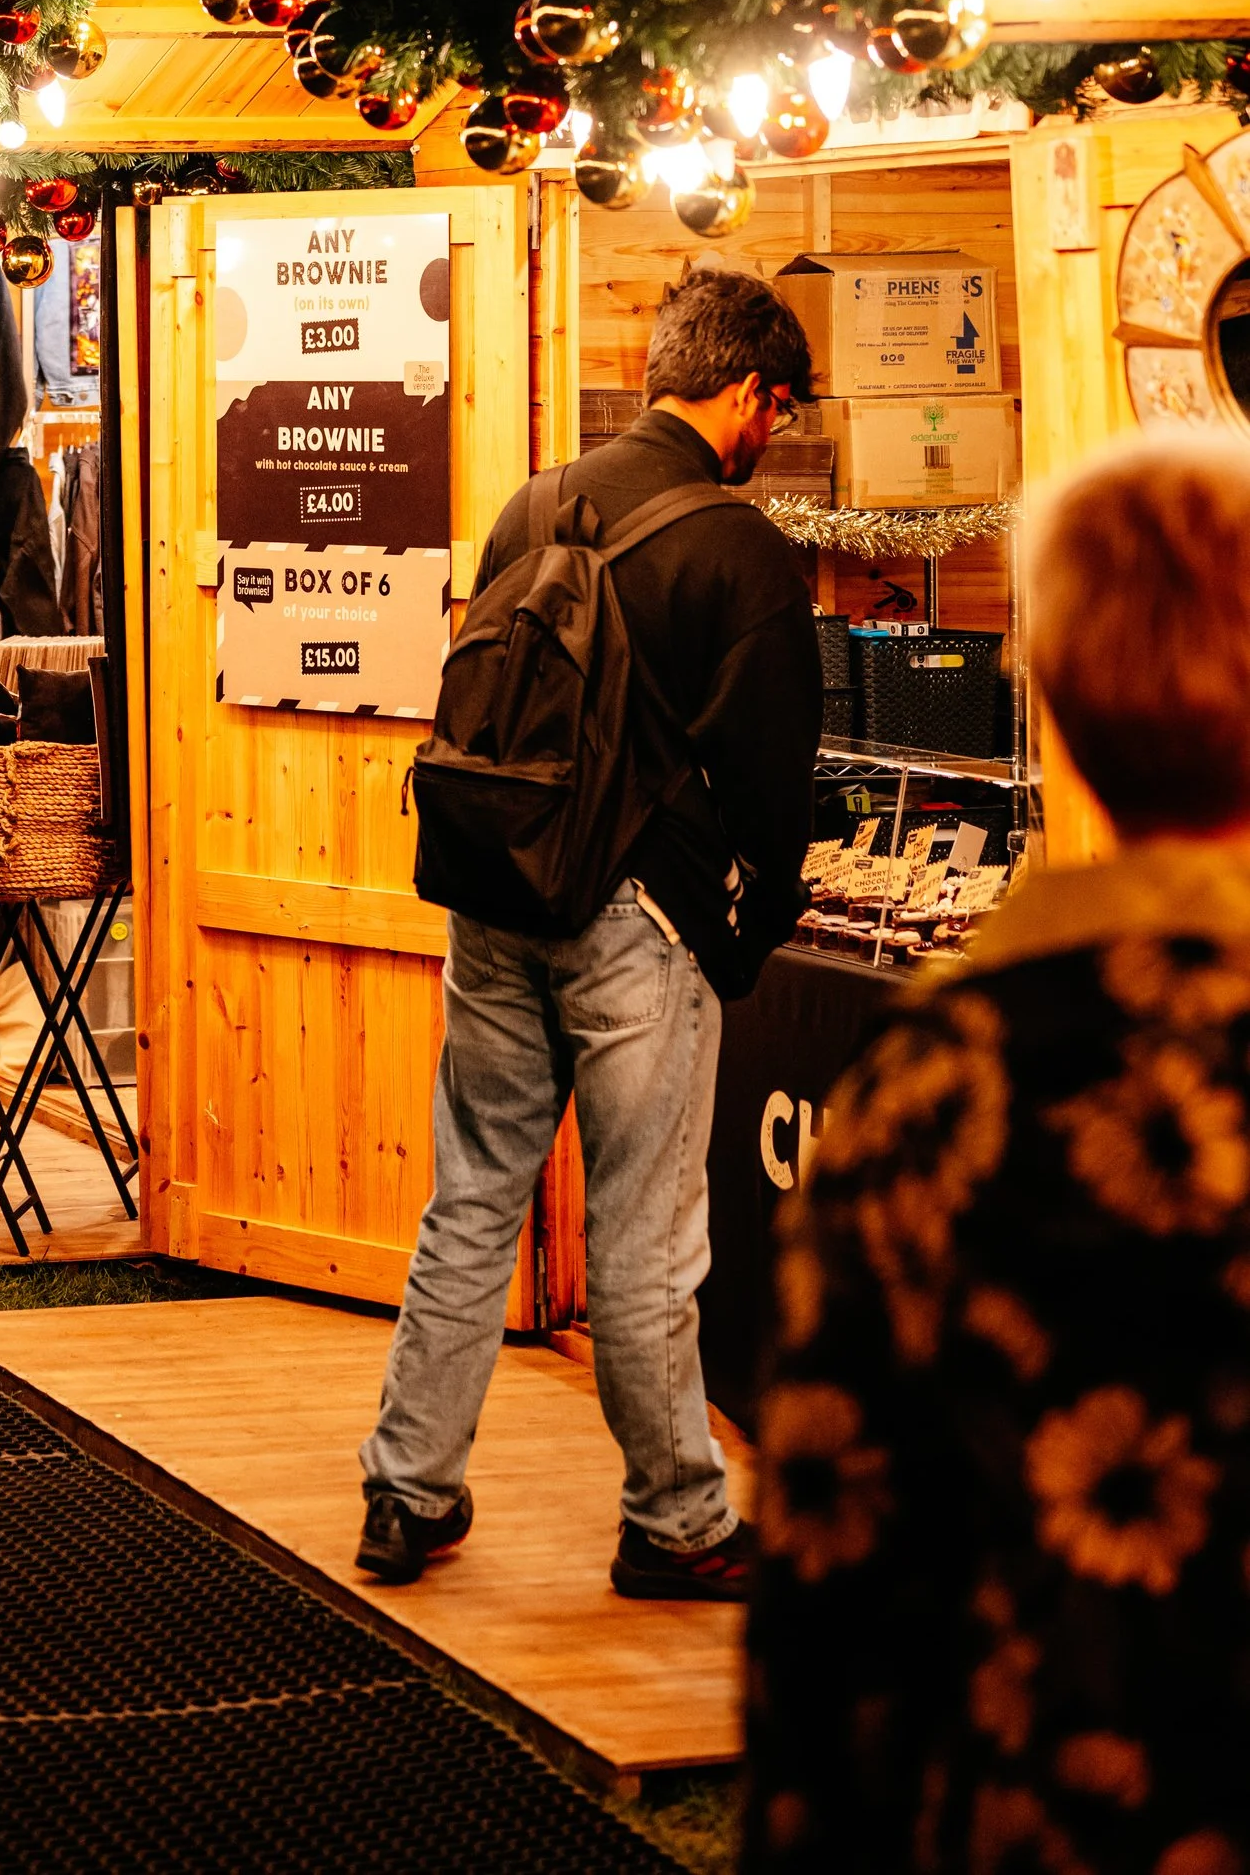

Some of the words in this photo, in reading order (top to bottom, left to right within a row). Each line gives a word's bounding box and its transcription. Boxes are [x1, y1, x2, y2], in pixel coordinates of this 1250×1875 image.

[307, 229, 356, 254] ANY
[276, 260, 388, 286] BROWNIE
[294, 296, 314, 312] (on
[318, 295, 334, 310] its
[338, 295, 370, 311] own)
[305, 325, 355, 349] £3.00
[946, 350, 985, 359] FRAGILE
[419, 364, 430, 373] The
[413, 373, 435, 382] deluxe
[413, 383, 435, 391] version
[307, 386, 354, 410] ANY
[277, 427, 385, 452] BROWNIE
[910, 433, 958, 442] edenware
[255, 459, 275, 470] with
[276, 459, 291, 470] hot
[293, 460, 338, 471] chocolate
[340, 462, 367, 472] sauce
[369, 462, 377, 471] &
[378, 462, 409, 473] cream
[306, 492, 354, 513] £4.00
[237, 574, 250, 586] Say
[250, 574, 256, 585] it
[256, 575, 272, 586] with
[284, 568, 332, 594] BOX
[341, 571, 373, 596] OF
[378, 574, 391, 596] 6
[237, 585, 270, 596] brownies!
[283, 603, 296, 618] of
[300, 606, 331, 622] your
[335, 605, 378, 621] choice
[304, 648, 357, 667] £15.00
[804, 849, 831, 862] ASPBERRY
[854, 874, 902, 888] CHOCOLTE
